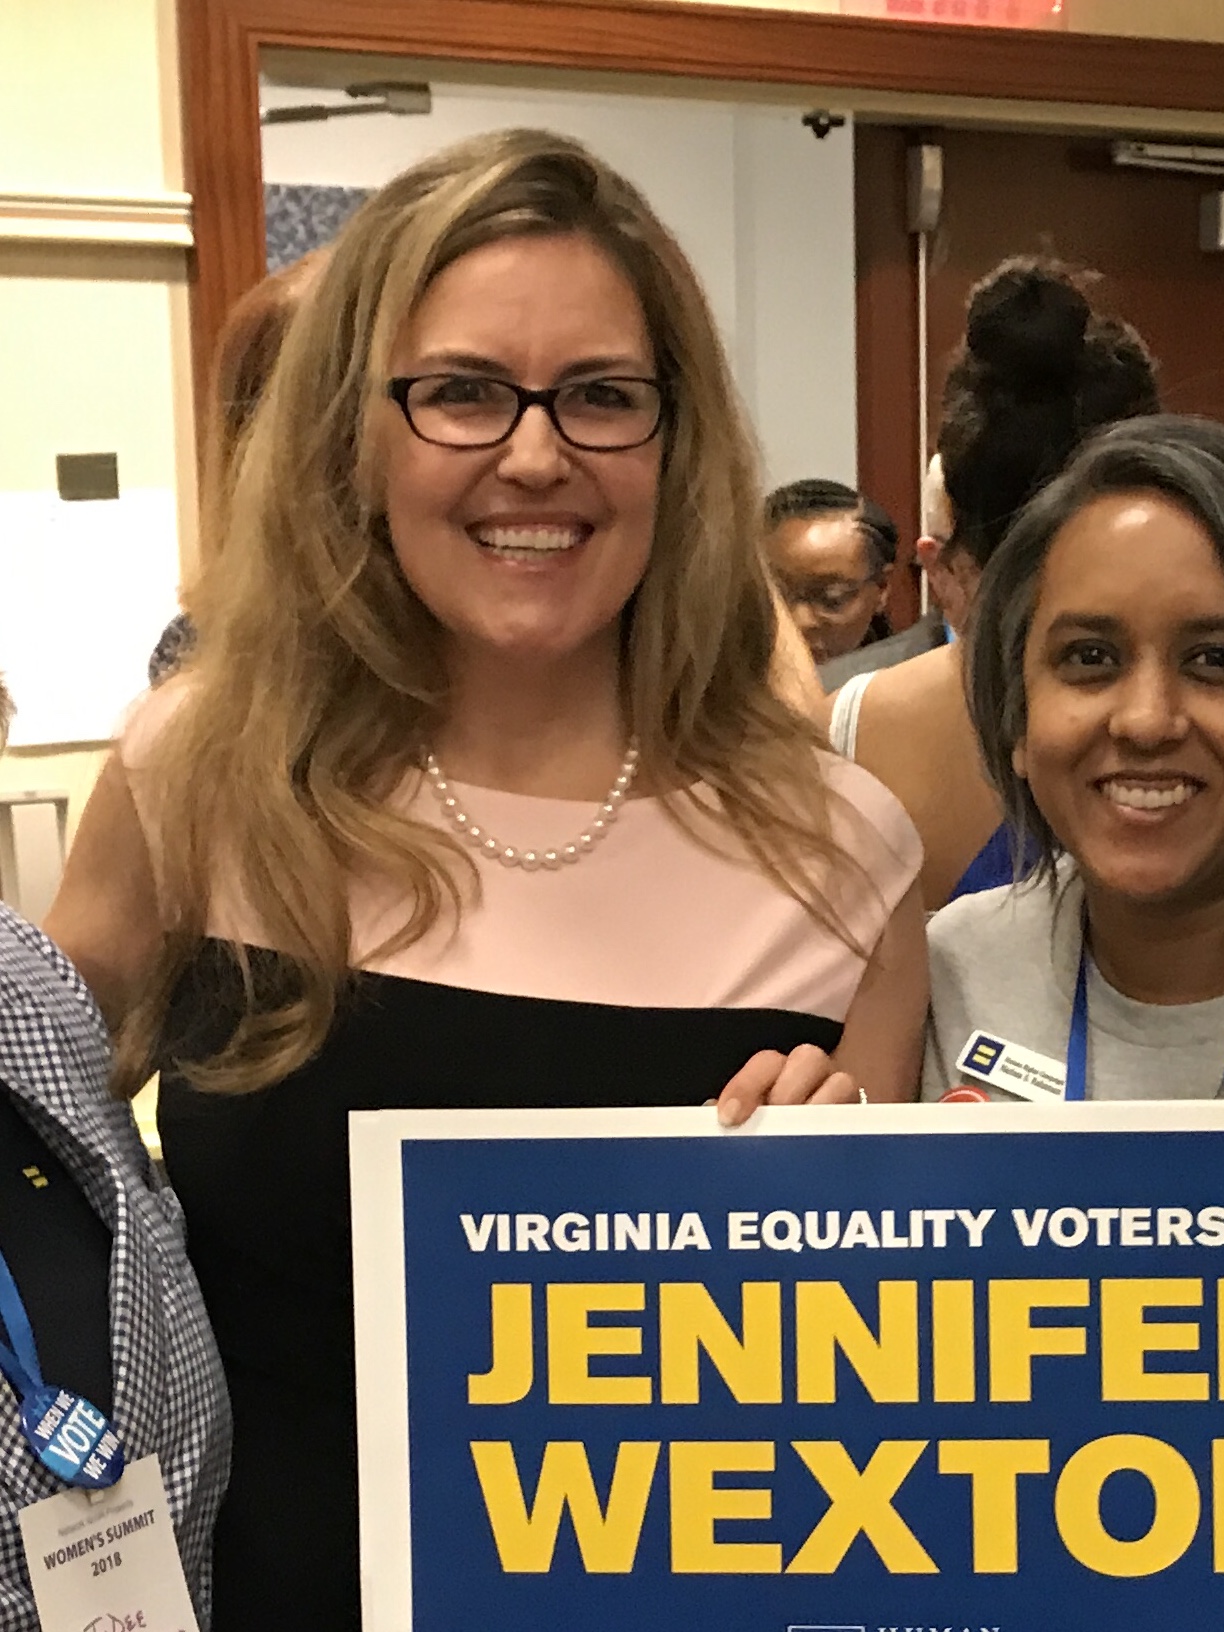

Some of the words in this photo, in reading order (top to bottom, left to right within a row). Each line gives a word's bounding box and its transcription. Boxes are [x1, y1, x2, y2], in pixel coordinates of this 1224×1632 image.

[459, 1211, 712, 1252] VIRGINIA
[727, 1208, 997, 1253] EQUALITY
[34, 1405, 65, 1440] WHEN
[49, 1398, 106, 1465] VOTE
[83, 1453, 107, 1479] WE
[43, 1532, 105, 1571] WOMEN'S
[106, 1509, 156, 1543] SUMMIT
[91, 1551, 122, 1577] 2018
